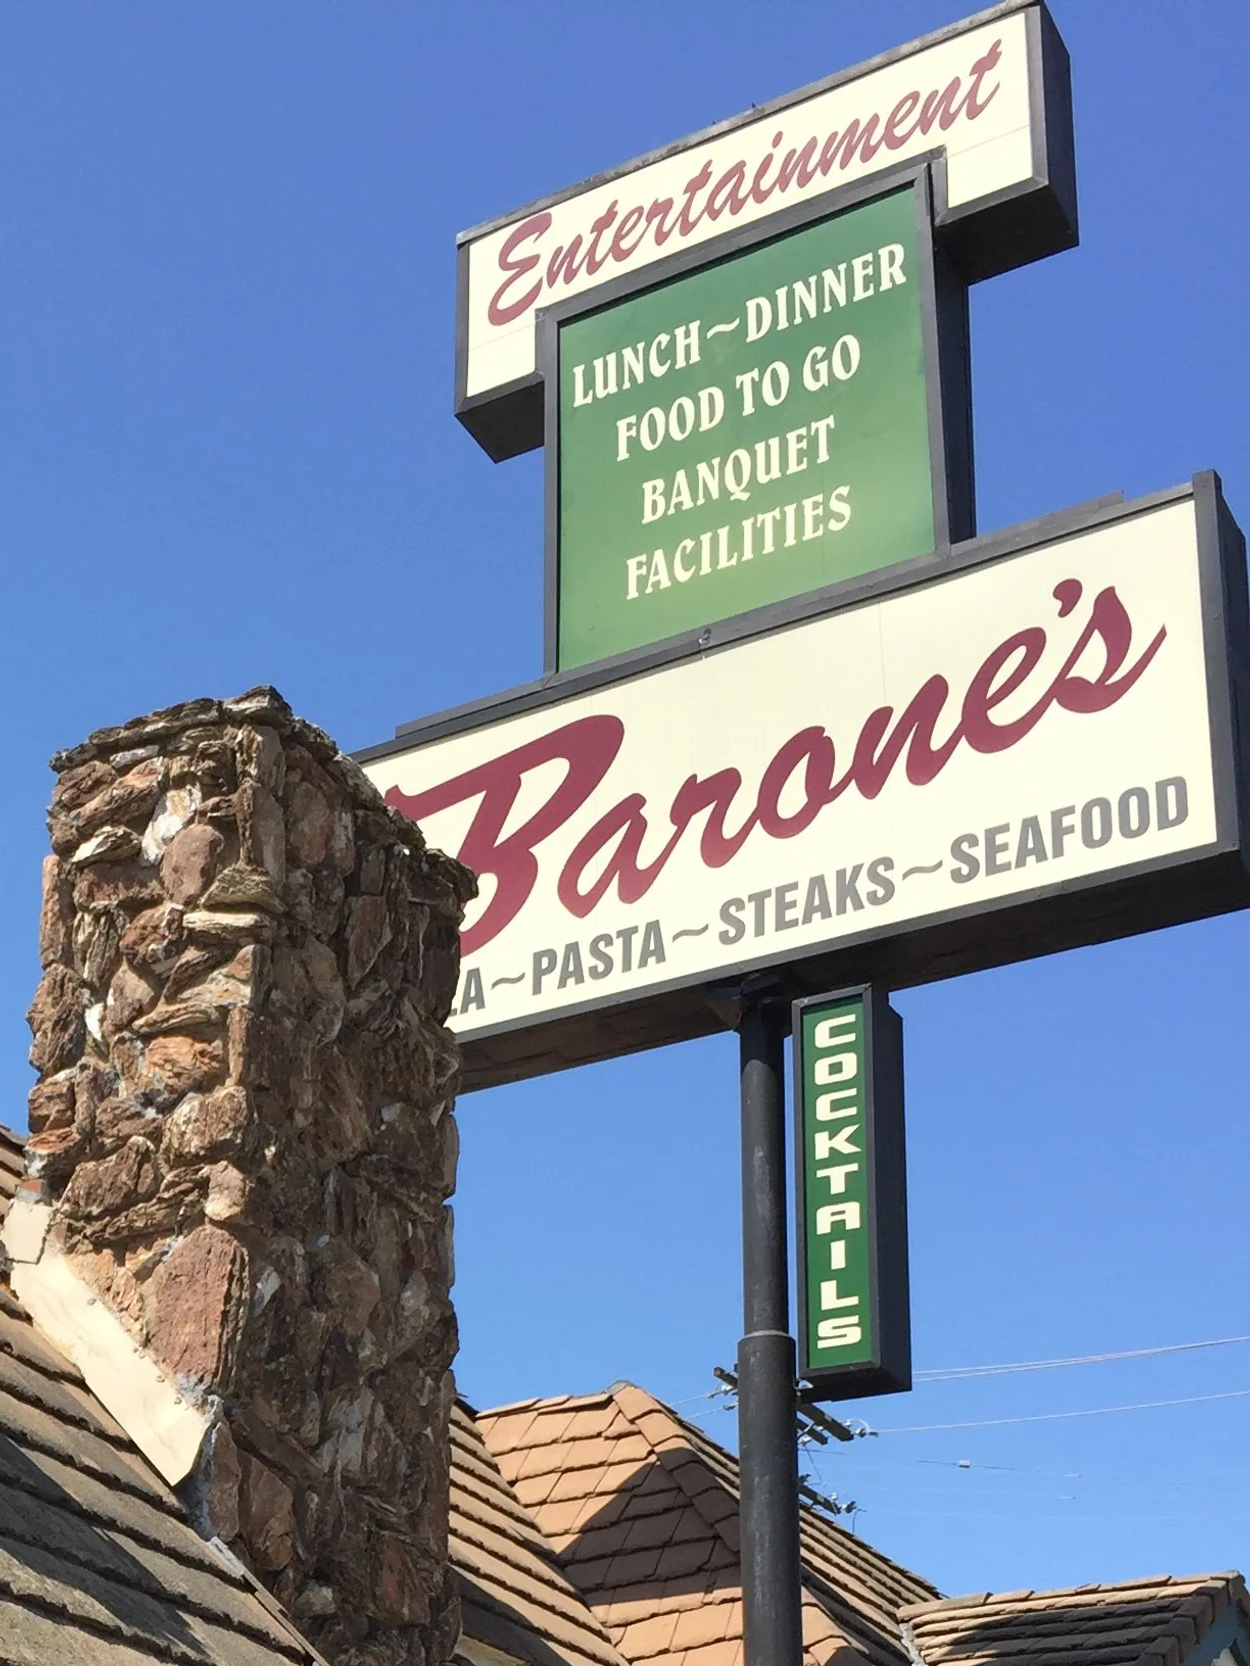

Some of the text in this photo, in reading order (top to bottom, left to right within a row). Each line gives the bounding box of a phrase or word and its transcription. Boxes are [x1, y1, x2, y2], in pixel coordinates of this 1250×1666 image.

[488, 39, 1002, 326] Entertainment
[616, 335, 861, 462] FOOD TO GO
[642, 415, 835, 524] BANQUET
[626, 485, 852, 600] FACILITIES
[385, 578, 1167, 957] Barone's
[814, 1013, 863, 1349] COCKTAILS
